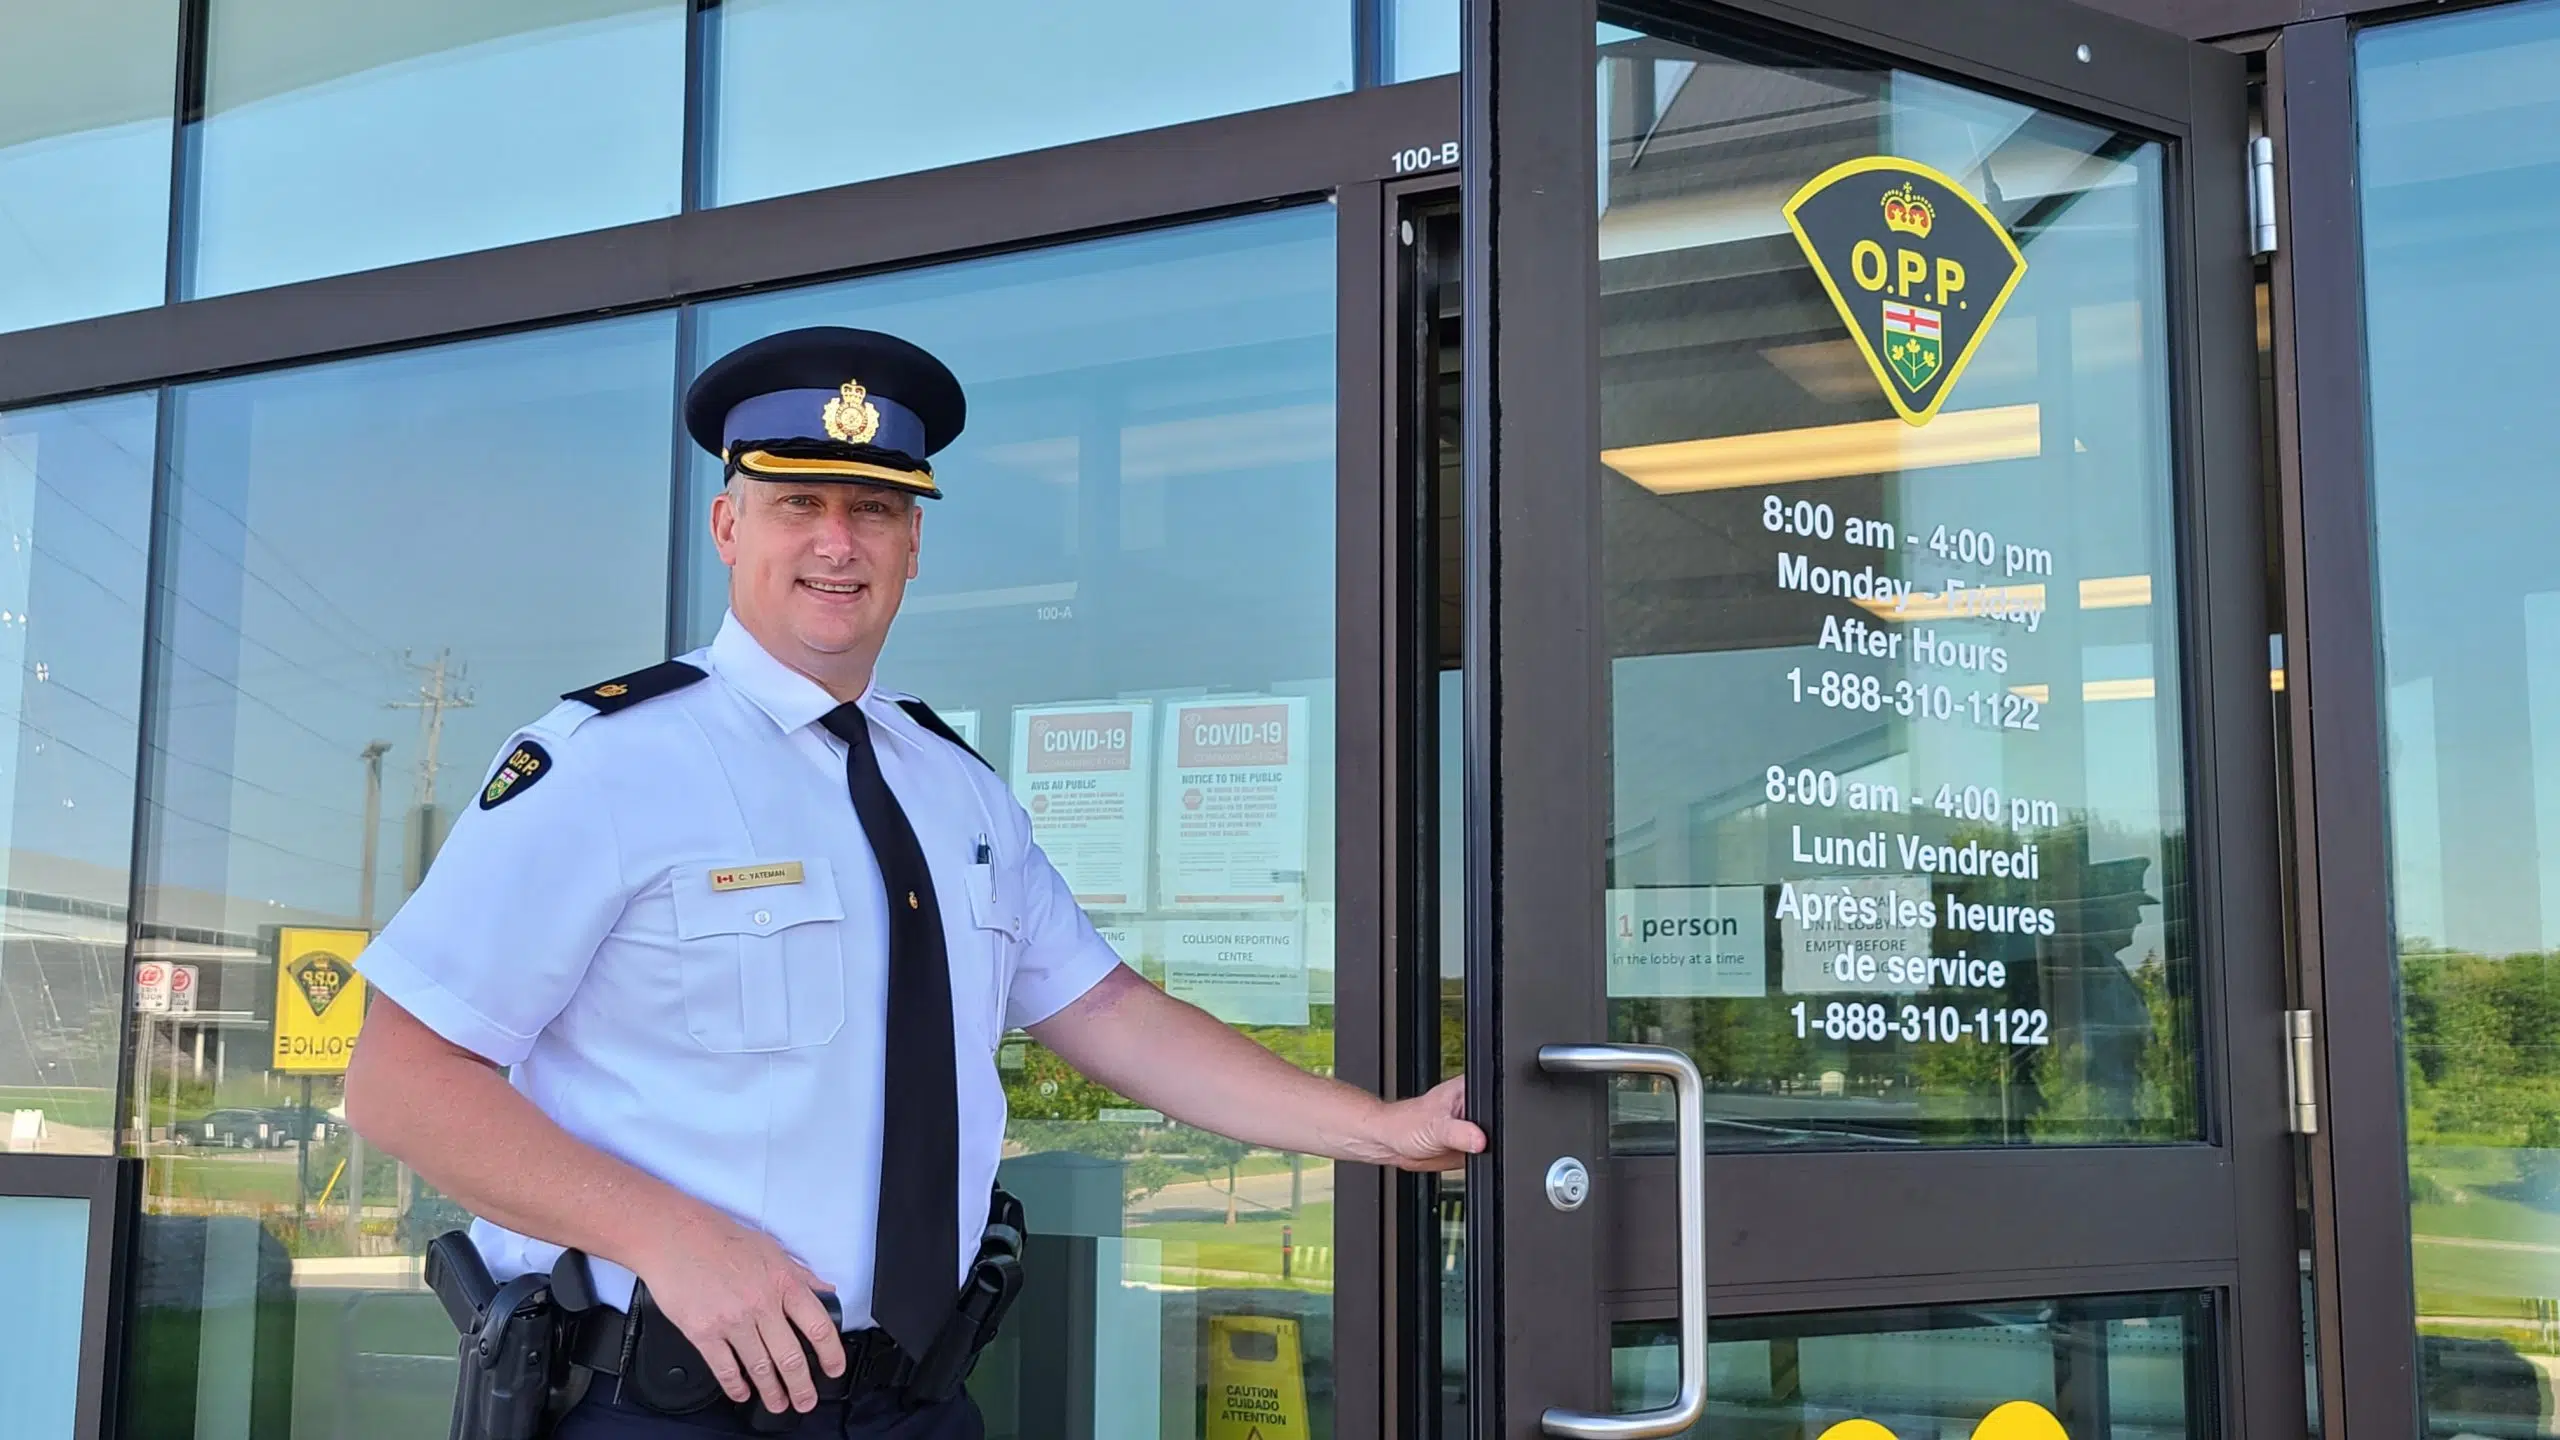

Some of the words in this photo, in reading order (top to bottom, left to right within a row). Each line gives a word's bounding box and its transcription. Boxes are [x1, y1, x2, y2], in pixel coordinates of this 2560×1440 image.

[1391, 142, 1459, 173] 100-B
[1851, 239, 1967, 310] O.P.P.
[1762, 494, 1835, 540] 8:00
[1844, 516, 1895, 550] am
[1929, 524, 1995, 566] 4:00
[2005, 542, 2053, 577] pm
[1777, 551, 1911, 613] Monday
[1946, 578, 2042, 632] Friday
[1036, 606, 1073, 620] 100-A
[1817, 614, 1902, 659] After
[1912, 626, 2008, 674] Hours
[1786, 665, 2040, 731] 1-888-310-1122
[1043, 727, 1127, 753] COVID-19
[1195, 721, 1283, 747] COVID-19
[1031, 780, 1050, 791] AVIS
[1051, 780, 1064, 791] AU
[1065, 779, 1097, 790] PUBLIC
[1182, 774, 1214, 785] NOTICE
[1216, 773, 1228, 784] TO
[1230, 773, 1246, 784] THE
[1249, 772, 1283, 783] PUBLIC
[1765, 765, 1838, 807] 8:00
[1849, 781, 1900, 813] am
[1934, 782, 2000, 822] 4:00
[2010, 796, 2059, 832] pm
[1791, 824, 1887, 869] Lundi
[1897, 833, 2040, 880] Vendredi
[749, 869, 786, 881] YATEMAN
[1774, 882, 1878, 930] Après
[1888, 889, 1938, 928] les
[1947, 893, 2056, 937] heures
[1182, 934, 1232, 945] COLLISION
[1234, 935, 1290, 946] REPORTING
[1616, 913, 1634, 939] 1
[1641, 915, 1738, 943] person
[1217, 951, 1253, 962] CENTRE
[1805, 939, 1851, 953] EMPTY
[1855, 938, 1908, 952] BEFORE
[1612, 953, 1624, 965] in
[1627, 952, 1648, 965] the
[1650, 952, 1686, 967] lobby
[1689, 953, 1702, 965] at
[1704, 955, 1712, 965] a
[1716, 953, 1745, 965] time
[1834, 944, 1876, 983] de
[1887, 950, 2007, 989] service
[1790, 1001, 2050, 1046] 1-888-310-1122
[1226, 1384, 1279, 1399] CAUTION
[1227, 1397, 1280, 1411] CUIDADO
[1221, 1410, 1287, 1425] ATTENTION
